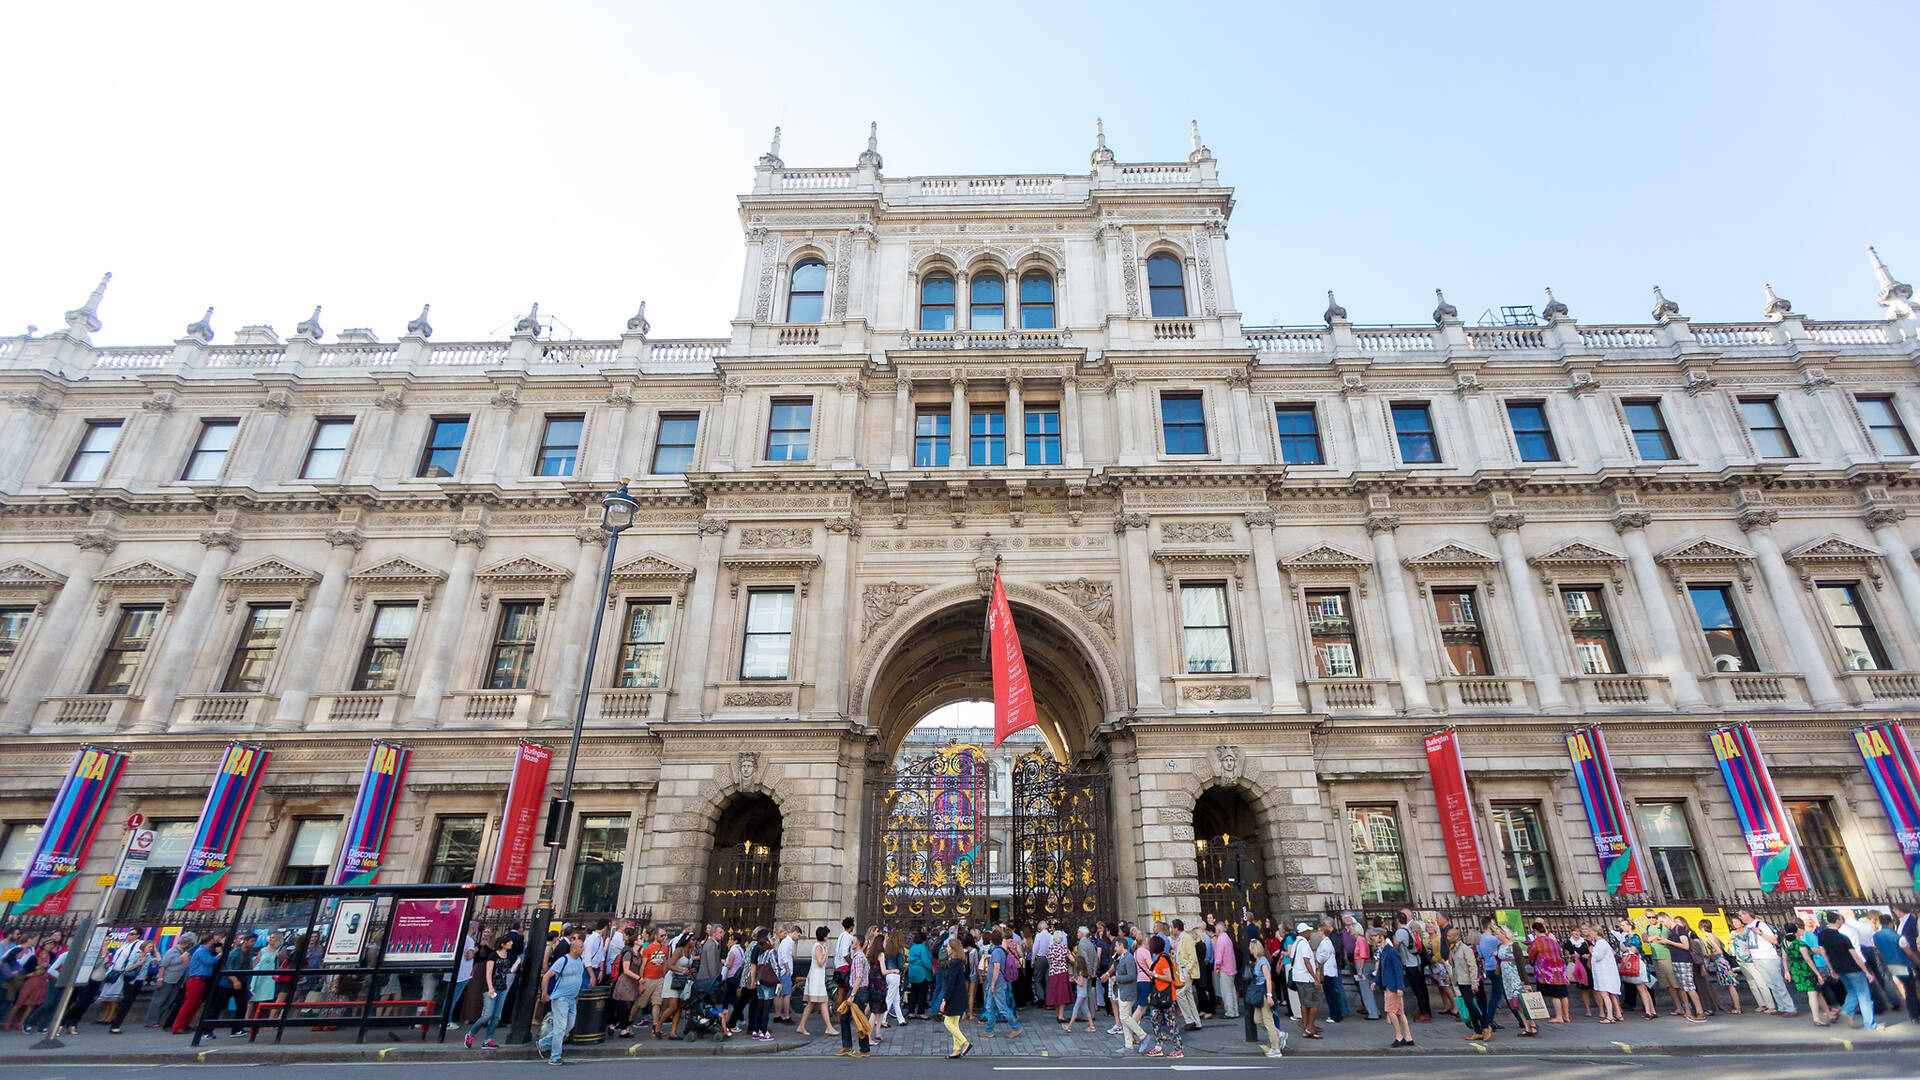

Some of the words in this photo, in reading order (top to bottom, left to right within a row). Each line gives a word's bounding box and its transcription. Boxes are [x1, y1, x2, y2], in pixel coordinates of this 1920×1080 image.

[1566, 733, 1592, 761] RA
[1710, 731, 1741, 761] RA
[1855, 729, 1891, 758] RA
[523, 753, 538, 763] House
[524, 746, 548, 759] Burlington
[75, 751, 110, 780] RA
[223, 747, 254, 776] RA
[372, 746, 396, 775] RA
[131, 815, 139, 826] L
[1595, 835, 1623, 845] Discover
[1746, 832, 1781, 842] Discover
[1596, 843, 1610, 852] The
[37, 854, 80, 864] Discover
[191, 849, 228, 860] Discover
[348, 849, 380, 860] Discover
[34, 861, 53, 871] The
[189, 856, 205, 867] The
[346, 856, 361, 866] The
